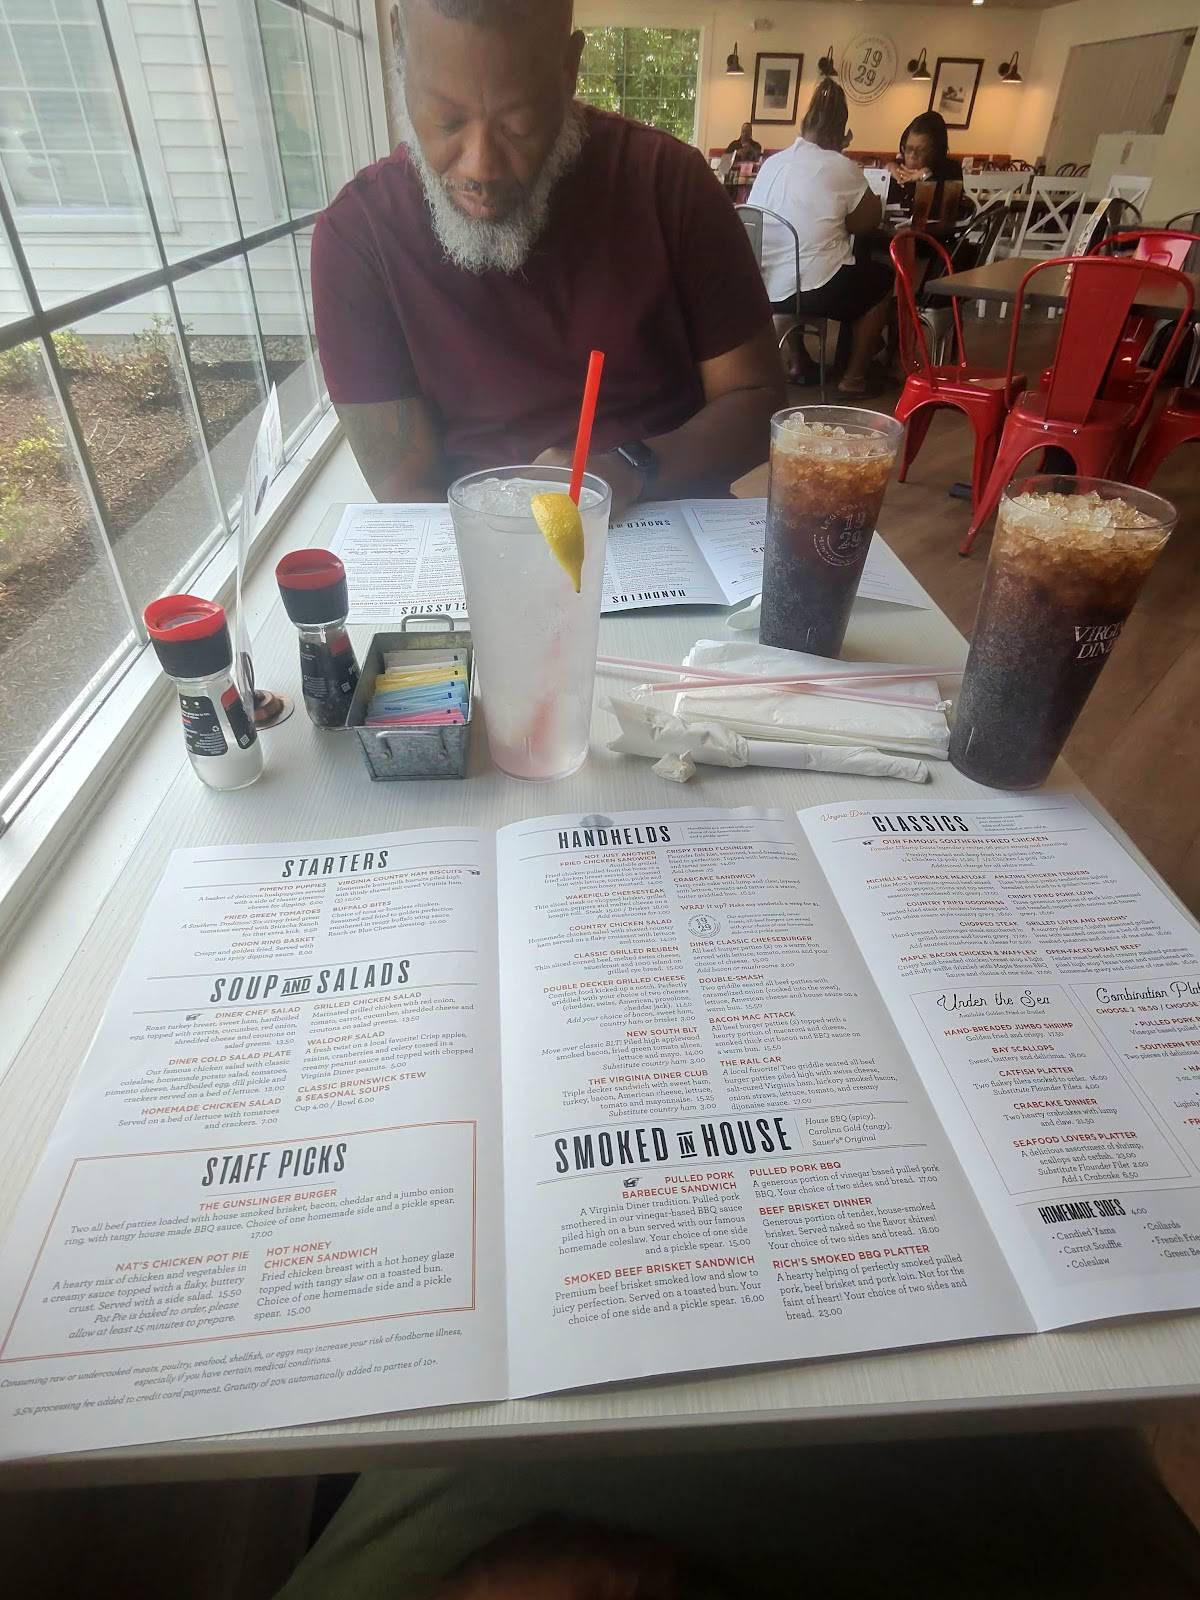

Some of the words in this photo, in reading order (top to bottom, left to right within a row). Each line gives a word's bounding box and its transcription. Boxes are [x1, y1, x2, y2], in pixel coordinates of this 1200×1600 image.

[863, 48, 882, 68] 19
[854, 65, 876, 86] 29
[628, 519, 671, 529] SMOKED
[612, 589, 686, 604] HANDHELDS
[871, 815, 969, 832] CLASSICS
[558, 825, 672, 849] HANDHELDS
[282, 850, 389, 878] STARTERS
[223, 913, 248, 921] FRIED
[249, 911, 277, 920] GREEN
[279, 908, 322, 917] TOMATOES
[231, 940, 260, 948] ONION
[283, 936, 315, 944] BASKET
[689, 940, 714, 948] DINER
[716, 938, 749, 946] CLASSIC
[751, 935, 812, 944] CHEESEBURGER
[209, 974, 279, 1003] SOUP
[281, 975, 313, 996] AND
[316, 959, 410, 994] SALADS
[543, 983, 578, 993] DOUBLE
[580, 979, 614, 989] DECKER
[616, 976, 651, 986] GRILLED
[653, 974, 686, 983] CHEESE
[699, 974, 764, 984] DOUBLE-SMASH
[936, 993, 987, 1011] Under
[995, 992, 1014, 1006] the
[1020, 989, 1050, 1008] Sea
[1096, 987, 1169, 1004] Combination
[1169, 981, 1200, 998] Plat
[313, 1000, 350, 1011] GRILLED
[352, 996, 391, 1006] CHICKEN
[392, 991, 422, 1001] SALAD
[1165, 1001, 1197, 1010] CHOOSE
[215, 1011, 243, 1019] DINER
[245, 1009, 269, 1017] CHEF
[271, 1006, 301, 1015] SALAD
[709, 1015, 740, 1024] BACON
[741, 1013, 761, 1022] MAC
[763, 1010, 796, 1020] ATTACK
[626, 1030, 647, 1038] NEW
[650, 1028, 680, 1036] SOUTH
[682, 1026, 698, 1034] BLT
[944, 1024, 1012, 1035] HAND-BREADED
[1015, 1023, 1043, 1031] JUMBO
[1043, 1022, 1073, 1030] SHRIMP
[307, 1035, 353, 1046] WALDORF
[354, 1031, 385, 1040] SALAD
[1140, 1042, 1184, 1050] SOUTHERN
[992, 1046, 1009, 1054] BAY
[1011, 1044, 1055, 1053] SCALLOPS
[168, 1057, 198, 1066] DINER
[200, 1055, 227, 1064] COLD
[229, 1052, 261, 1061] SALAD
[262, 1050, 291, 1059] PLATE
[720, 1059, 737, 1067] THE
[739, 1058, 760, 1066] RAIL
[762, 1056, 782, 1064] CAR
[588, 1077, 606, 1086] THE
[609, 1073, 651, 1084] VIRGINIA
[653, 1071, 682, 1080] DINER
[684, 1069, 708, 1078] CLUB
[999, 1068, 1036, 1077] CATFISH
[1036, 1066, 1073, 1075] PLATTER
[297, 1082, 337, 1094] CLASSIC
[340, 1075, 397, 1088] BRUNSWICK
[399, 1071, 426, 1081] STEW
[305, 1089, 356, 1101] SEASONAL
[359, 1084, 390, 1095] SOUPS
[141, 1104, 200, 1116] HOMEMADE
[202, 1101, 246, 1111] CHICKEN
[249, 1098, 281, 1107] SALAD
[294, 1102, 311, 1113] Cup
[312, 1100, 329, 1109] 4.00
[330, 1100, 336, 1110] /
[337, 1097, 356, 1107] Bowl
[357, 1096, 375, 1105] 6.00
[1013, 1100, 1063, 1110] CRABCAKE
[1062, 1098, 1097, 1107] DINNER
[805, 1116, 829, 1125] House
[830, 1114, 848, 1126] BBQ
[848, 1112, 876, 1124] (spicy),
[808, 1126, 842, 1136] Carolina
[843, 1124, 861, 1134] Gold
[862, 1122, 892, 1134] (tangy),
[554, 1127, 669, 1174] SMOKED
[677, 1132, 697, 1157] IN
[700, 1117, 792, 1157] HOUSE
[1013, 1136, 1060, 1147] SEAFOOD
[1061, 1133, 1097, 1143] LOVERS
[1098, 1131, 1137, 1141] PLATTER
[201, 1151, 271, 1187] STAFF
[278, 1142, 347, 1179] PICKS
[749, 1166, 787, 1178] PULLED
[790, 1163, 817, 1174] PORK
[820, 1160, 841, 1171] BBQ
[664, 1173, 704, 1185] PULLED
[706, 1171, 734, 1181] PORK
[622, 1186, 678, 1199] BARBECUE
[681, 1181, 737, 1194] SANDWICH
[199, 1201, 220, 1212] THE
[223, 1194, 291, 1209] GUNSLINGER
[294, 1188, 337, 1201] BURGER
[759, 1205, 785, 1216] BEEF
[788, 1201, 829, 1213] BRISKET
[833, 1196, 872, 1209] DINNER
[1038, 1201, 1098, 1225] HOMEMADE
[1093, 1198, 1127, 1218] SIDES
[1056, 1228, 1094, 1240] Candied
[1093, 1226, 1116, 1237] Yams
[1146, 1220, 1181, 1230] Collards
[768, 1239, 788, 1249] Your
[790, 1236, 818, 1247] choice
[820, 1235, 829, 1244] of
[830, 1233, 846, 1243] two
[848, 1231, 870, 1242] sides
[871, 1229, 887, 1240] and
[888, 1227, 915, 1238] bread.
[918, 1224, 939, 1235] 18.00
[1155, 1233, 1184, 1245] French
[266, 1246, 290, 1257] HOT
[293, 1241, 331, 1254] HONEY
[1063, 1243, 1092, 1255] Carrot
[1091, 1240, 1123, 1252] Souffle
[1163, 1248, 1189, 1258] Green
[115, 1260, 149, 1273] NAT'S
[152, 1256, 203, 1269] CHICKEN
[206, 1252, 229, 1264] POT
[231, 1250, 249, 1261] PIE
[264, 1255, 314, 1270] CHICKEN
[317, 1247, 377, 1263] SANDWICH
[772, 1257, 807, 1269] RICH'S
[810, 1252, 856, 1266] SMOKED
[858, 1249, 881, 1261] BBQ
[883, 1244, 929, 1257] PLATTER
[1071, 1256, 1111, 1269] Coleslaw
[564, 1270, 611, 1285] SMOKED
[615, 1266, 642, 1278] BEEF
[646, 1261, 691, 1274] BRISKET
[695, 1254, 755, 1270] SANDWICH
[786, 1309, 814, 1319] bread.
[818, 1307, 842, 1317] 23.00
